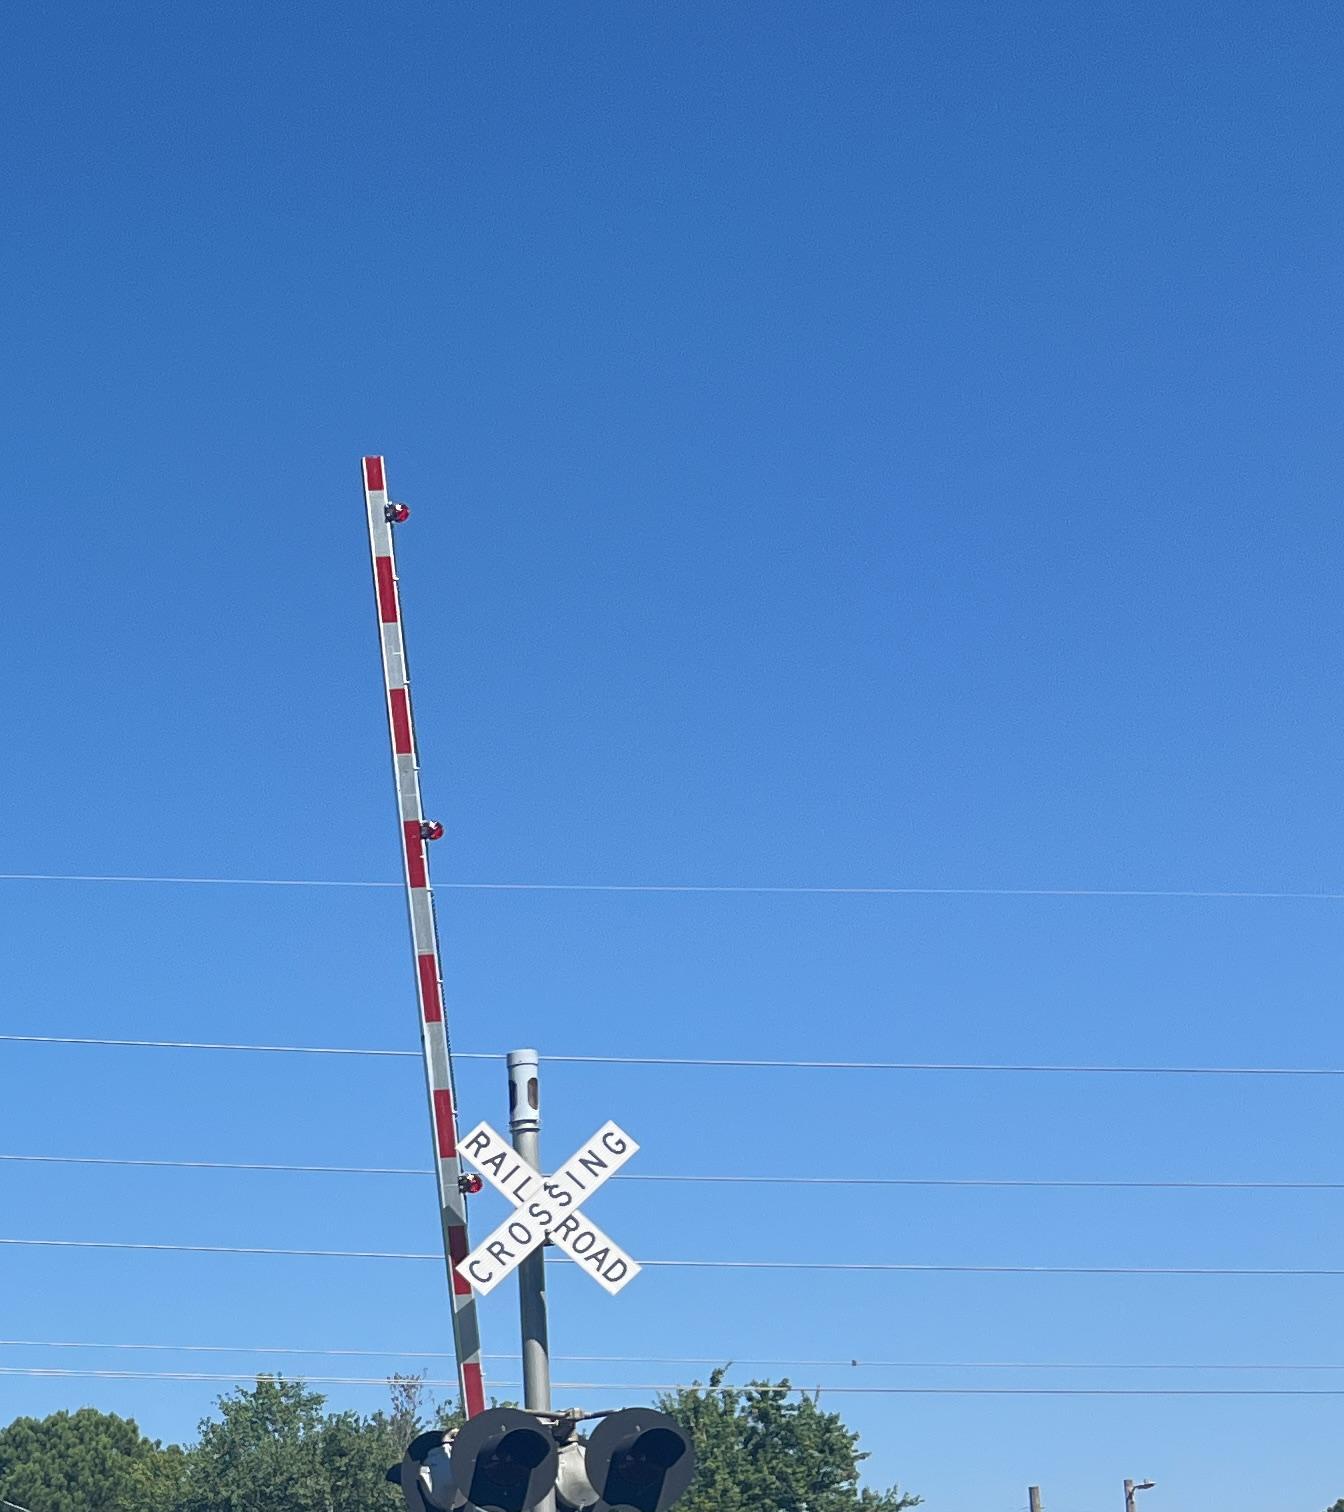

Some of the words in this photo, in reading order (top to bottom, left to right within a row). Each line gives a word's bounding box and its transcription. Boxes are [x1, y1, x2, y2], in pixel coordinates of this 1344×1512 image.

[465, 1130, 532, 1202] RAIL
[553, 1214, 628, 1283] ROAD
[468, 1132, 627, 1284] CROSSING
